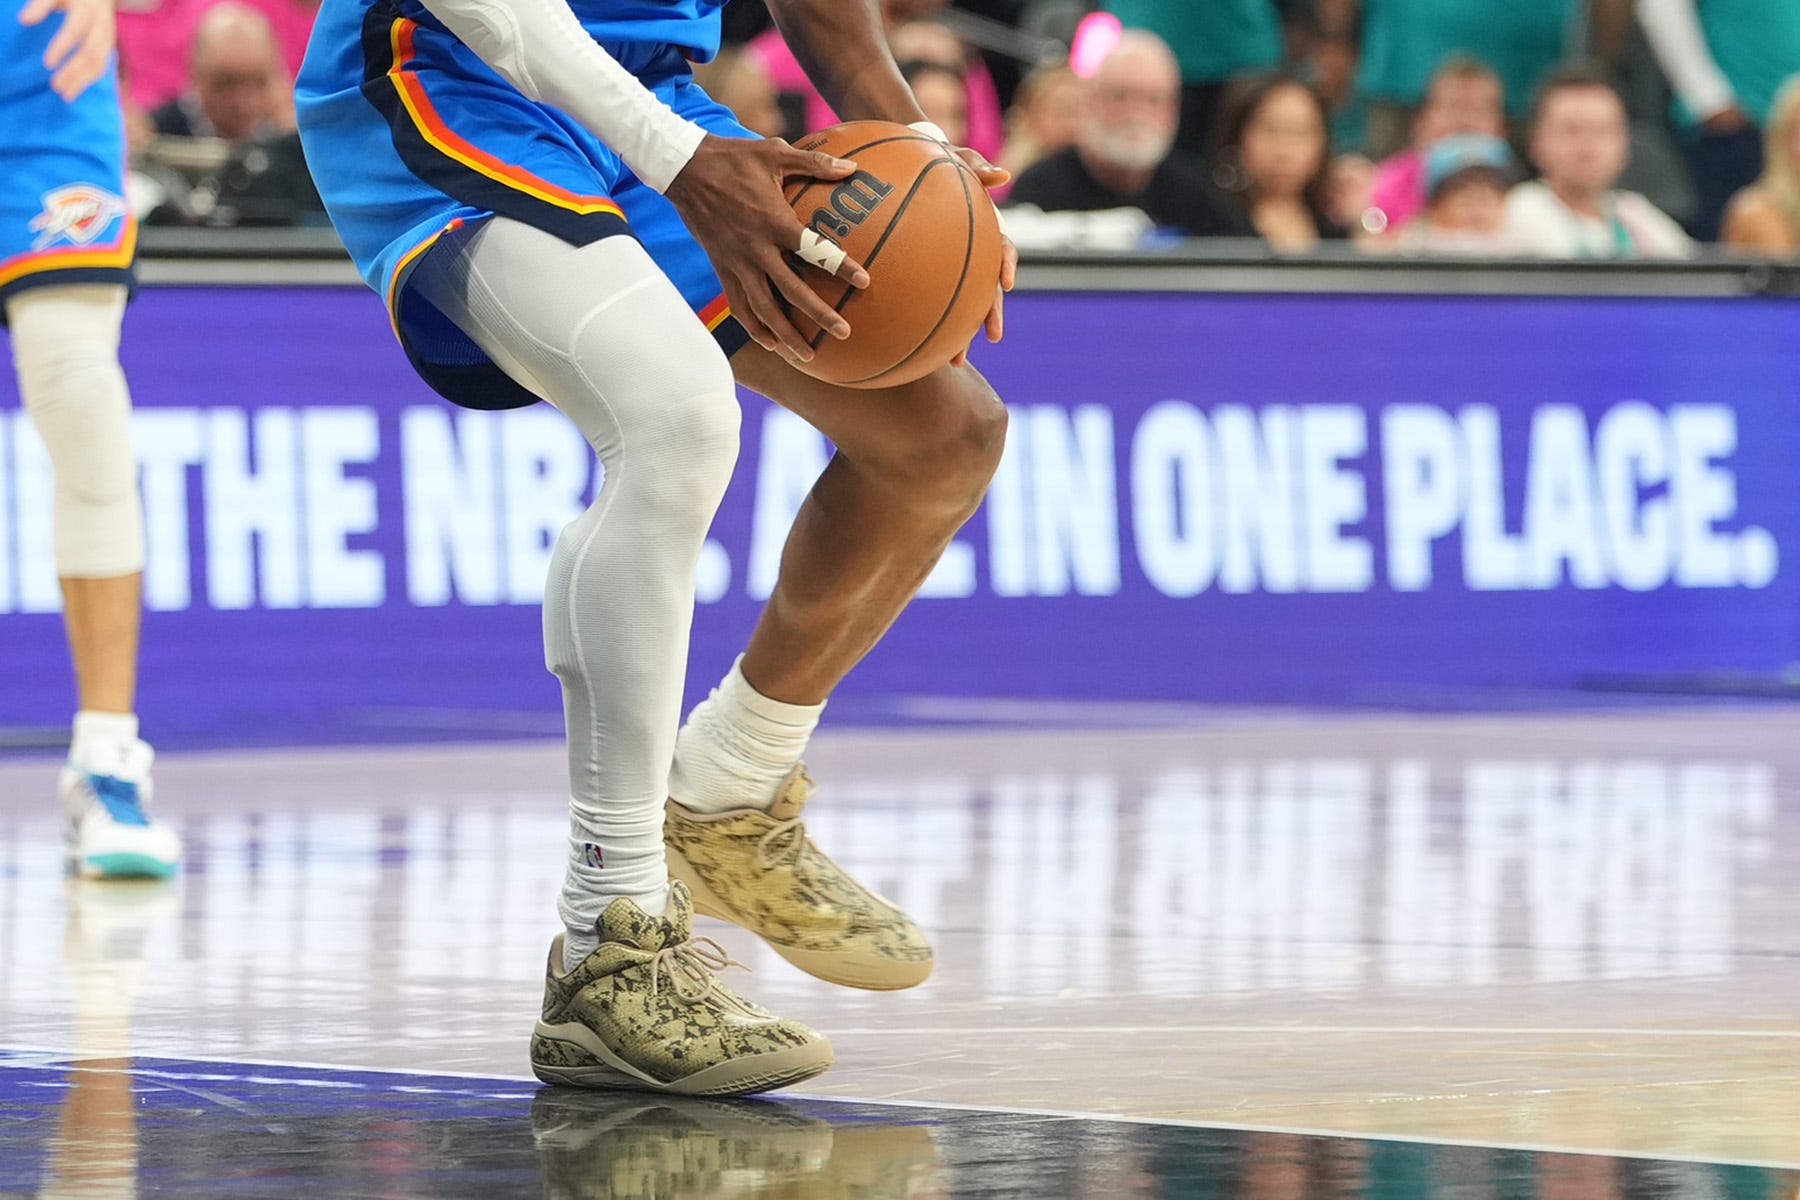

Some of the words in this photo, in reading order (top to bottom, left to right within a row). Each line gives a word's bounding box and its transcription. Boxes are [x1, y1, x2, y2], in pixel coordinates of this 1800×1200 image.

[130, 405, 387, 612] THE
[988, 403, 1121, 598] IN
[1130, 400, 1374, 599] ONE
[1380, 400, 1780, 593] PLACE.
